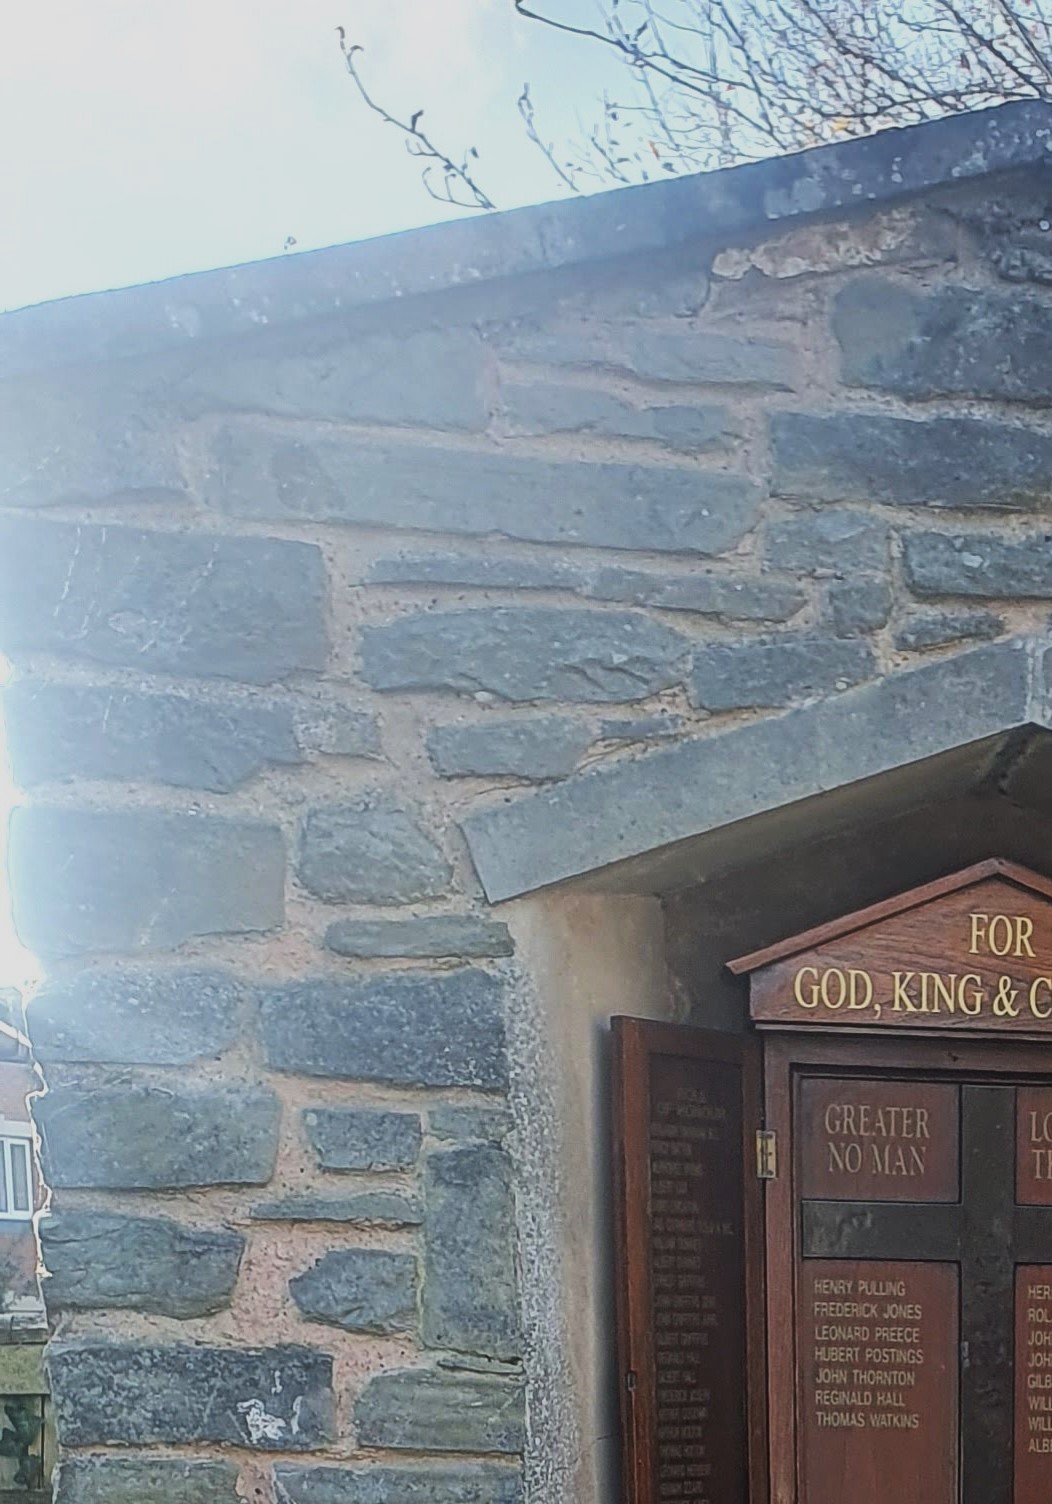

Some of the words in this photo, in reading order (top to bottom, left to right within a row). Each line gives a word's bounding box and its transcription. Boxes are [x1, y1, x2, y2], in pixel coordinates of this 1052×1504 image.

[969, 913, 1036, 957] FOR
[794, 967, 882, 1017] GOD,
[892, 971, 983, 1015] KING
[993, 976, 1020, 1017] &
[824, 1104, 930, 1139] GREATER
[828, 1141, 862, 1174] NO
[871, 1143, 927, 1177] MAN
[814, 1279, 852, 1296] HENRY
[858, 1280, 906, 1297] PULLING
[814, 1302, 878, 1318] FREDERICK
[883, 1304, 922, 1320] JONES
[815, 1327, 869, 1342] LEONARD
[875, 1327, 919, 1343] PREECE
[814, 1347, 859, 1362] HUBERT
[865, 1349, 924, 1365] POSTINGS
[816, 1370, 848, 1385] JOHN
[852, 1371, 915, 1387] THORNTON
[815, 1390, 872, 1406] REGINALD
[816, 1412, 865, 1428] THOMAS
[870, 1412, 919, 1429] WATKINS
